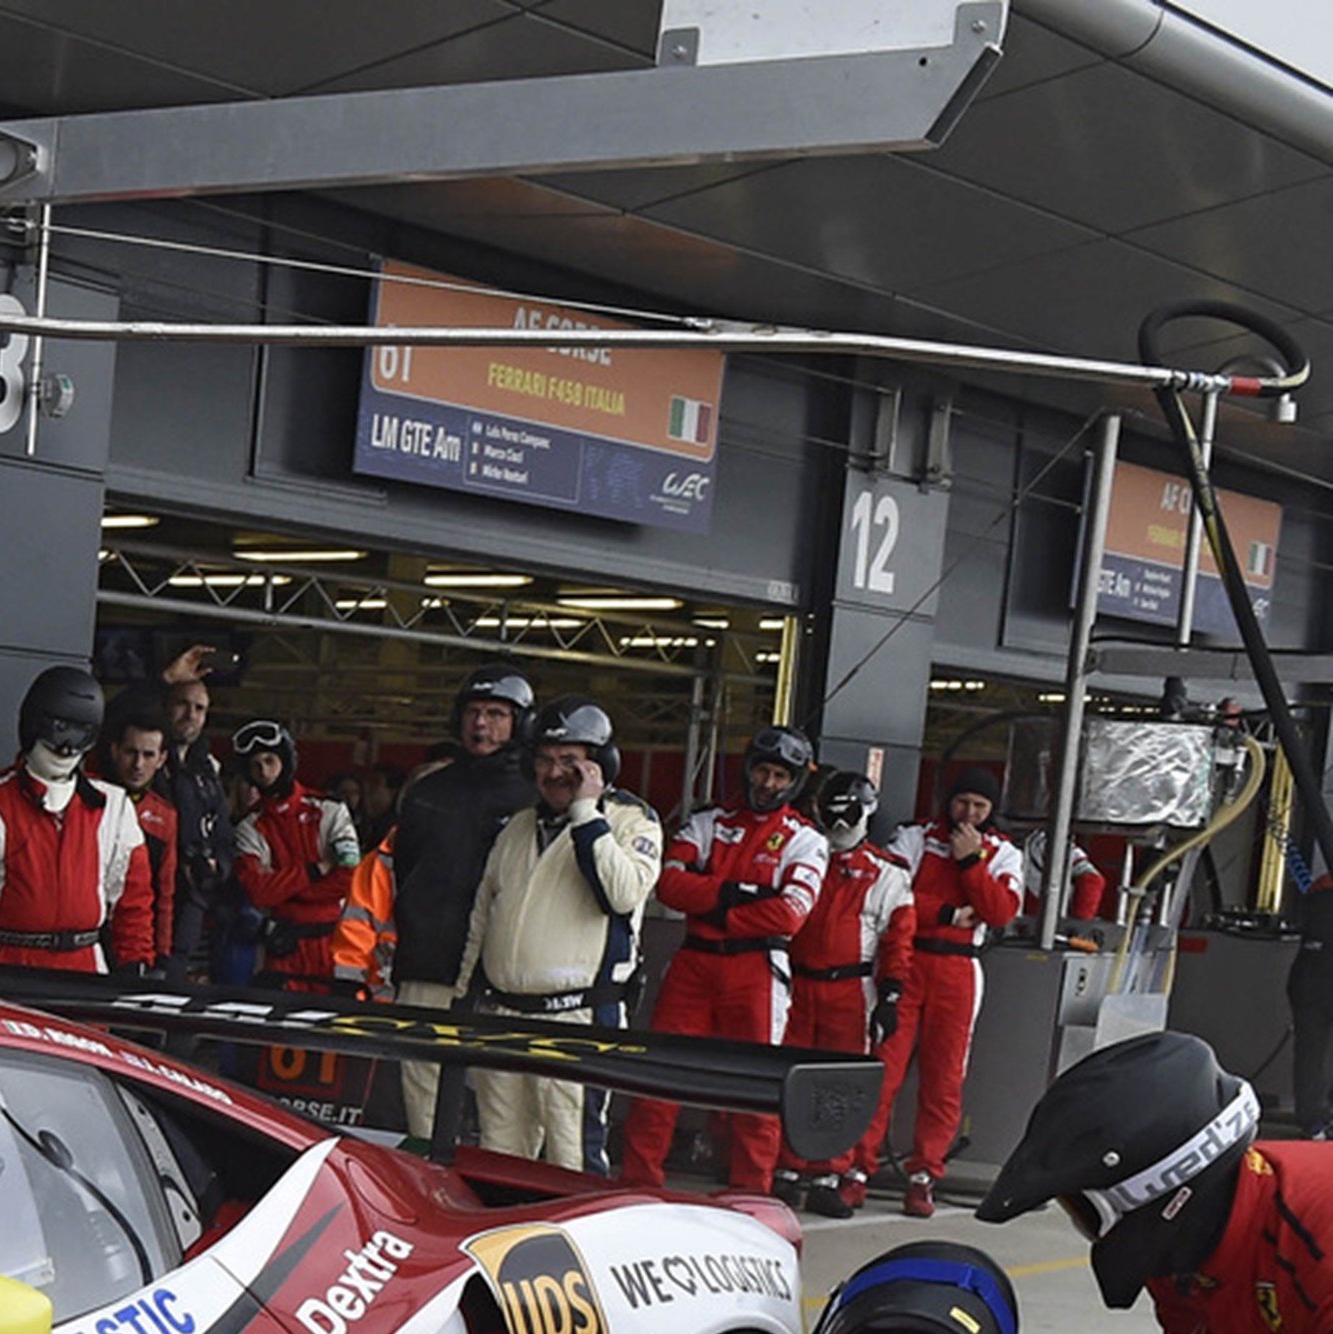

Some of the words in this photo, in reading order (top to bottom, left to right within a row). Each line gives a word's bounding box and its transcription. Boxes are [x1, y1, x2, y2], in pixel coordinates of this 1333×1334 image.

[489, 363, 545, 398] FERRARI
[585, 386, 625, 415] ITALIA
[371, 414, 399, 449] LM
[400, 419, 432, 457] GTE
[433, 427, 461, 462] Am
[662, 473, 710, 500] WEC
[851, 491, 900, 594] 12
[609, 1260, 674, 1309] WE
[689, 1254, 792, 1301] LOGISTICS
